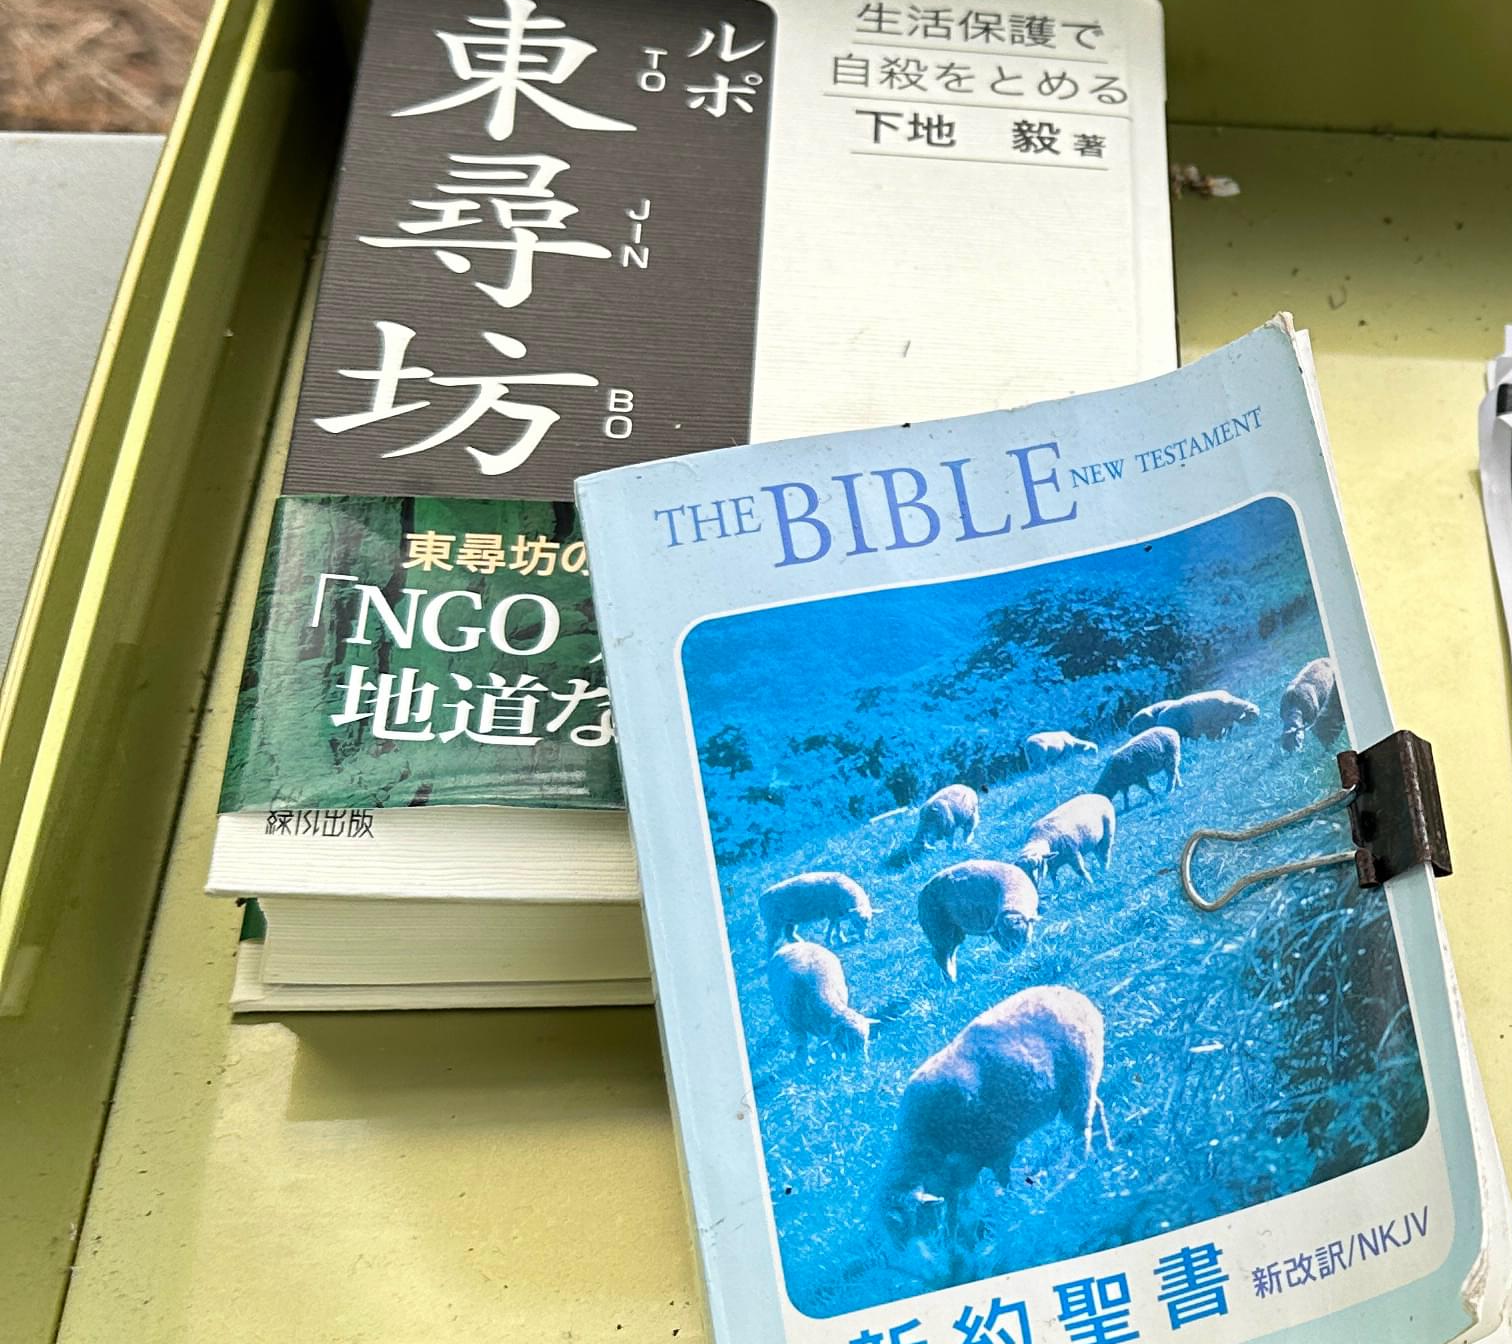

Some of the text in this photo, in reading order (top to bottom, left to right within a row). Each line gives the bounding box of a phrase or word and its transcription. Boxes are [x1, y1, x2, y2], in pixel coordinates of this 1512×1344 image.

[684, 20, 766, 120] ルポ
[856, 2, 1106, 51] 生活保護で
[832, 53, 1129, 105] 自殺をとめる
[855, 109, 957, 148] 下地
[654, 406, 1266, 569] THE BIBLE NEW TESTAMENT
[310, 573, 603, 664] 「NGO
[1251, 1205, 1431, 1300] 新改訳/NKJV
